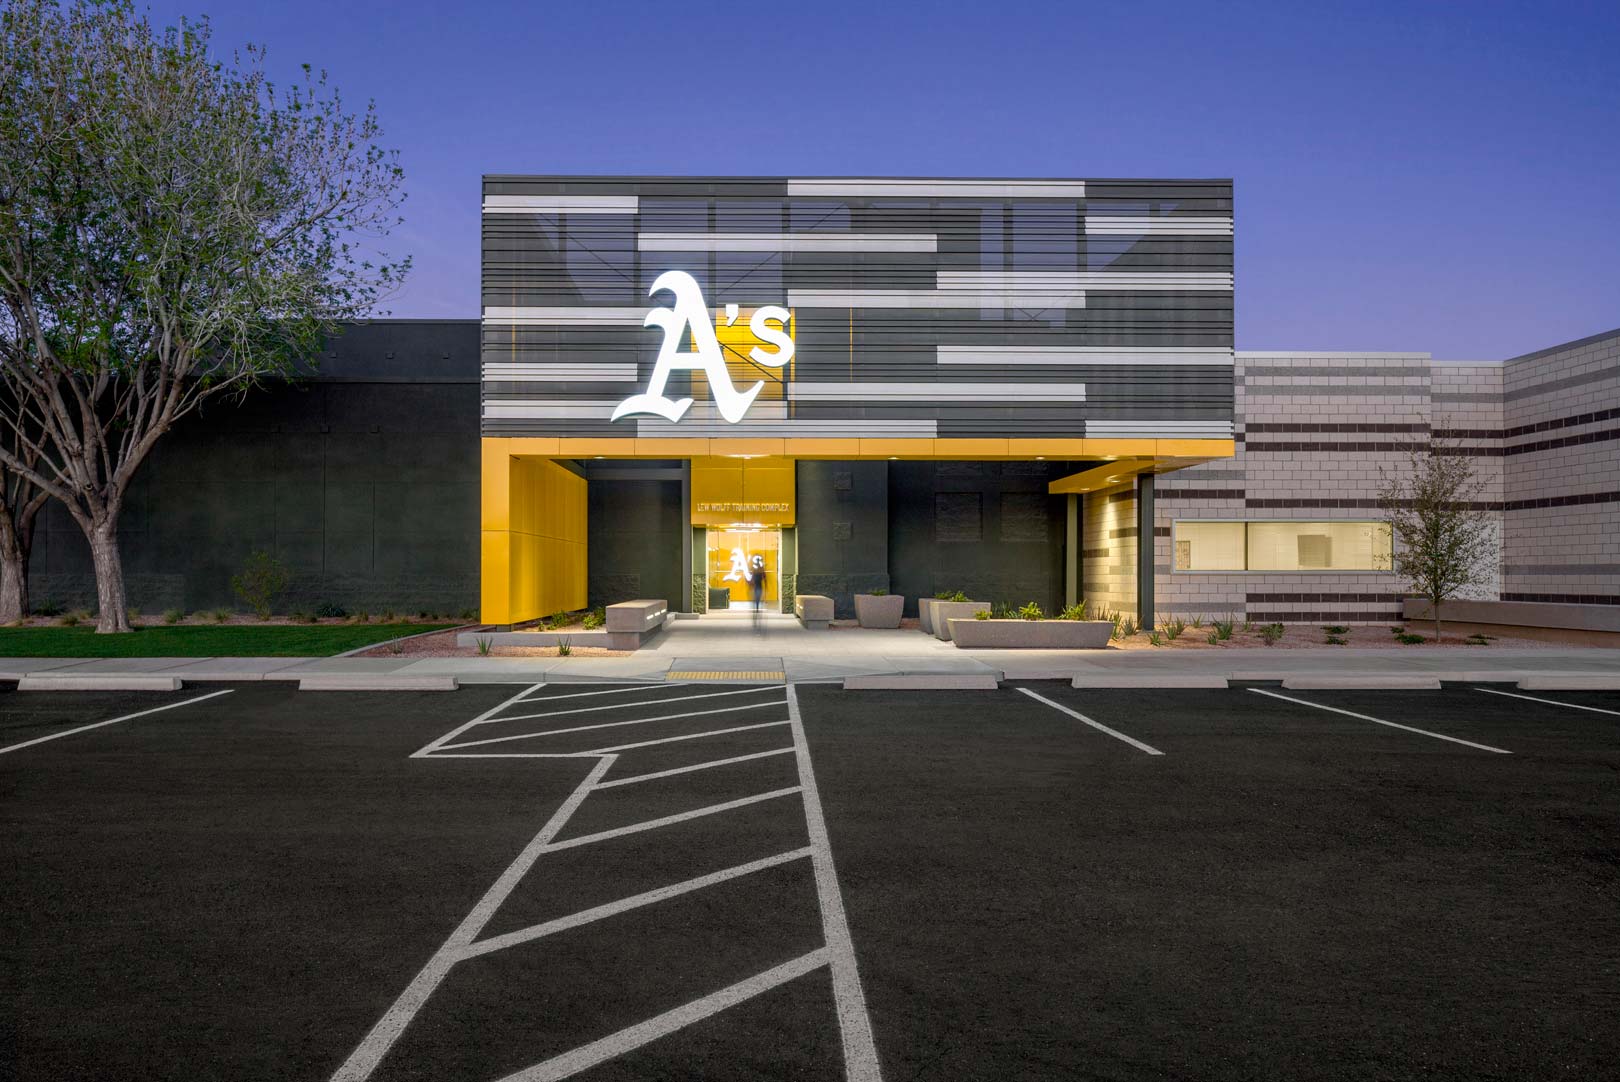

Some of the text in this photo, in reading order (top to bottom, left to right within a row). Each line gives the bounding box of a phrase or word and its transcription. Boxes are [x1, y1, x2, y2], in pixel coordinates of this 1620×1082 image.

[610, 270, 795, 424] A's
[697, 503, 790, 512] LEW WOLFF TRAINING COMPLEX
[722, 547, 763, 582] A's
